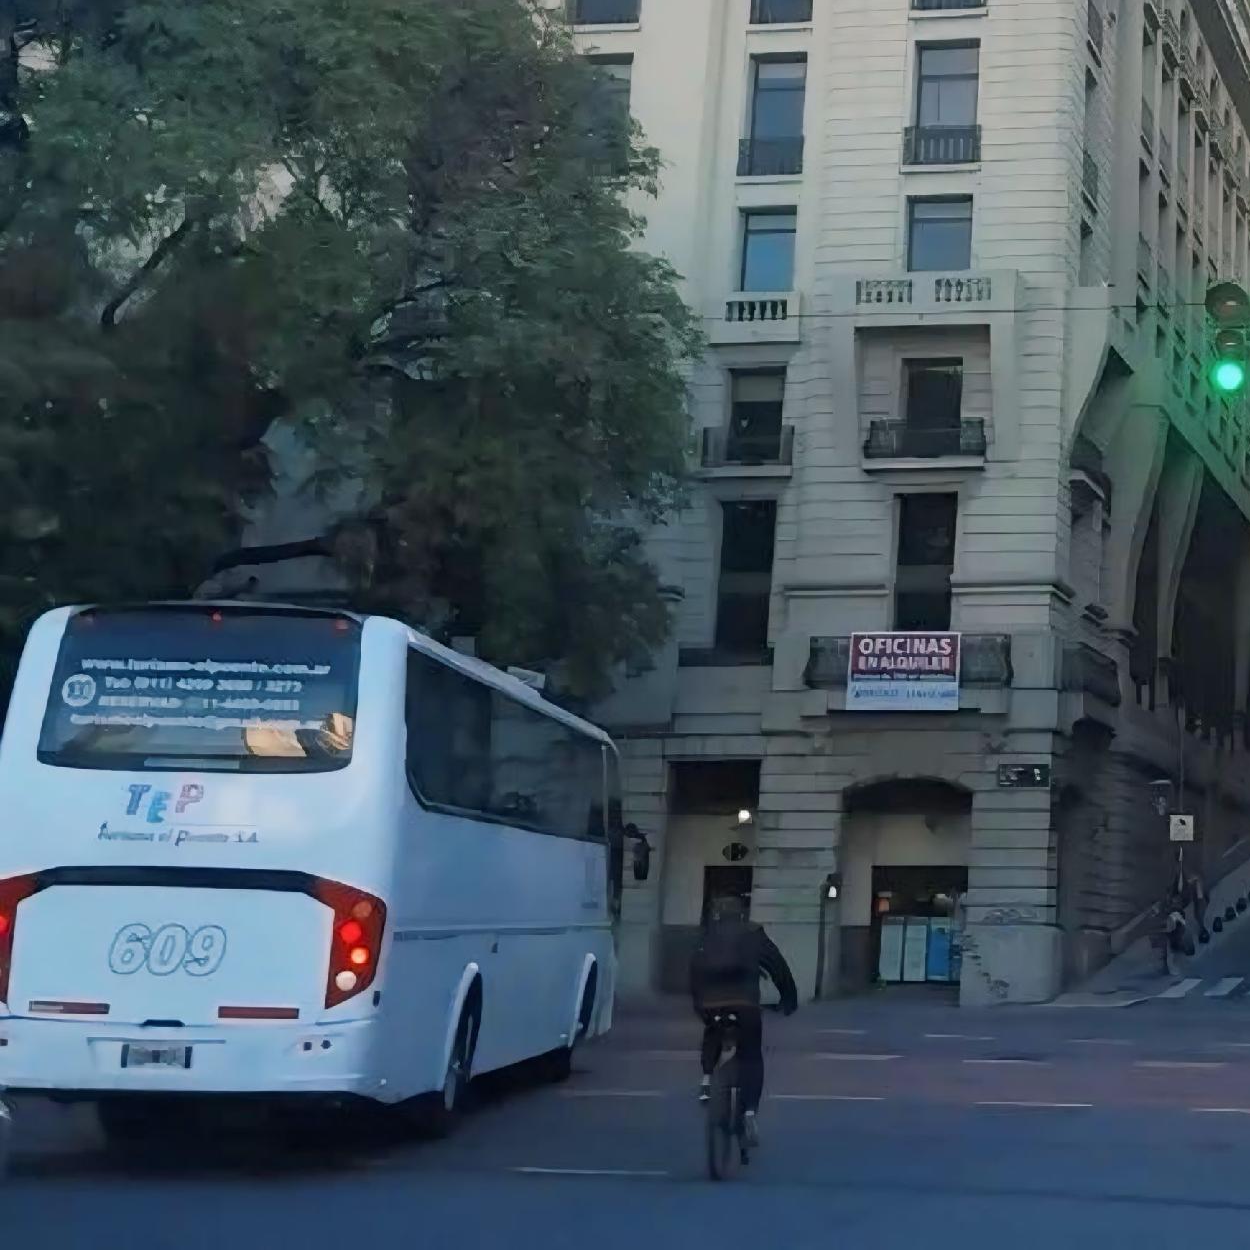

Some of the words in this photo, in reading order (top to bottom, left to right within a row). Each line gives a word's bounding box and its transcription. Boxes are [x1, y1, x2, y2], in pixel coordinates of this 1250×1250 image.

[859, 638, 952, 655] OFICINAS
[126, 784, 205, 823] TEP
[109, 923, 227, 977] 609
